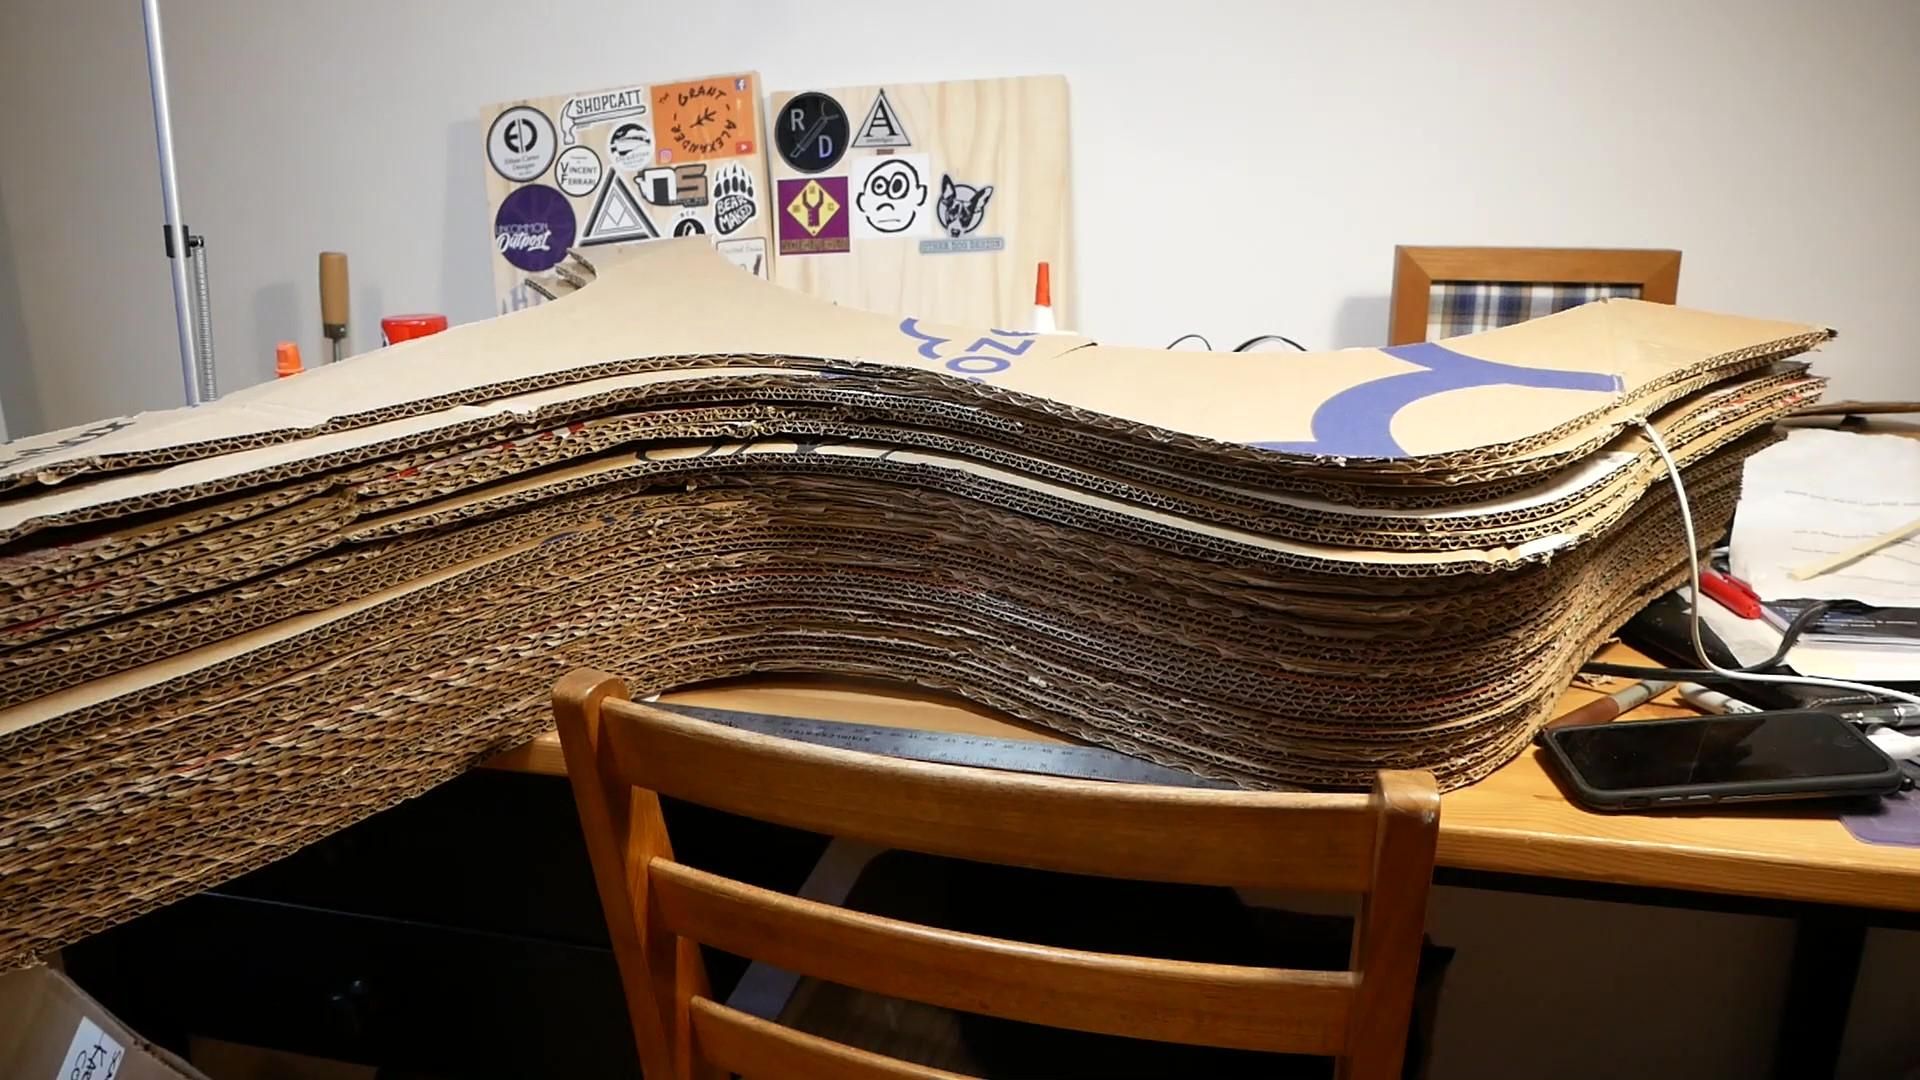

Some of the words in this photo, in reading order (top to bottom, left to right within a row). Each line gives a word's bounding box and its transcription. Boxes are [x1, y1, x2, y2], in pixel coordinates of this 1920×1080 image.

[575, 89, 641, 114] SHOPCATT
[677, 85, 727, 107] GRANT
[790, 108, 805, 132] R
[863, 98, 900, 138] A
[670, 119, 737, 155] ALEXANDER
[818, 134, 833, 159] D
[560, 161, 598, 174] VINCENT
